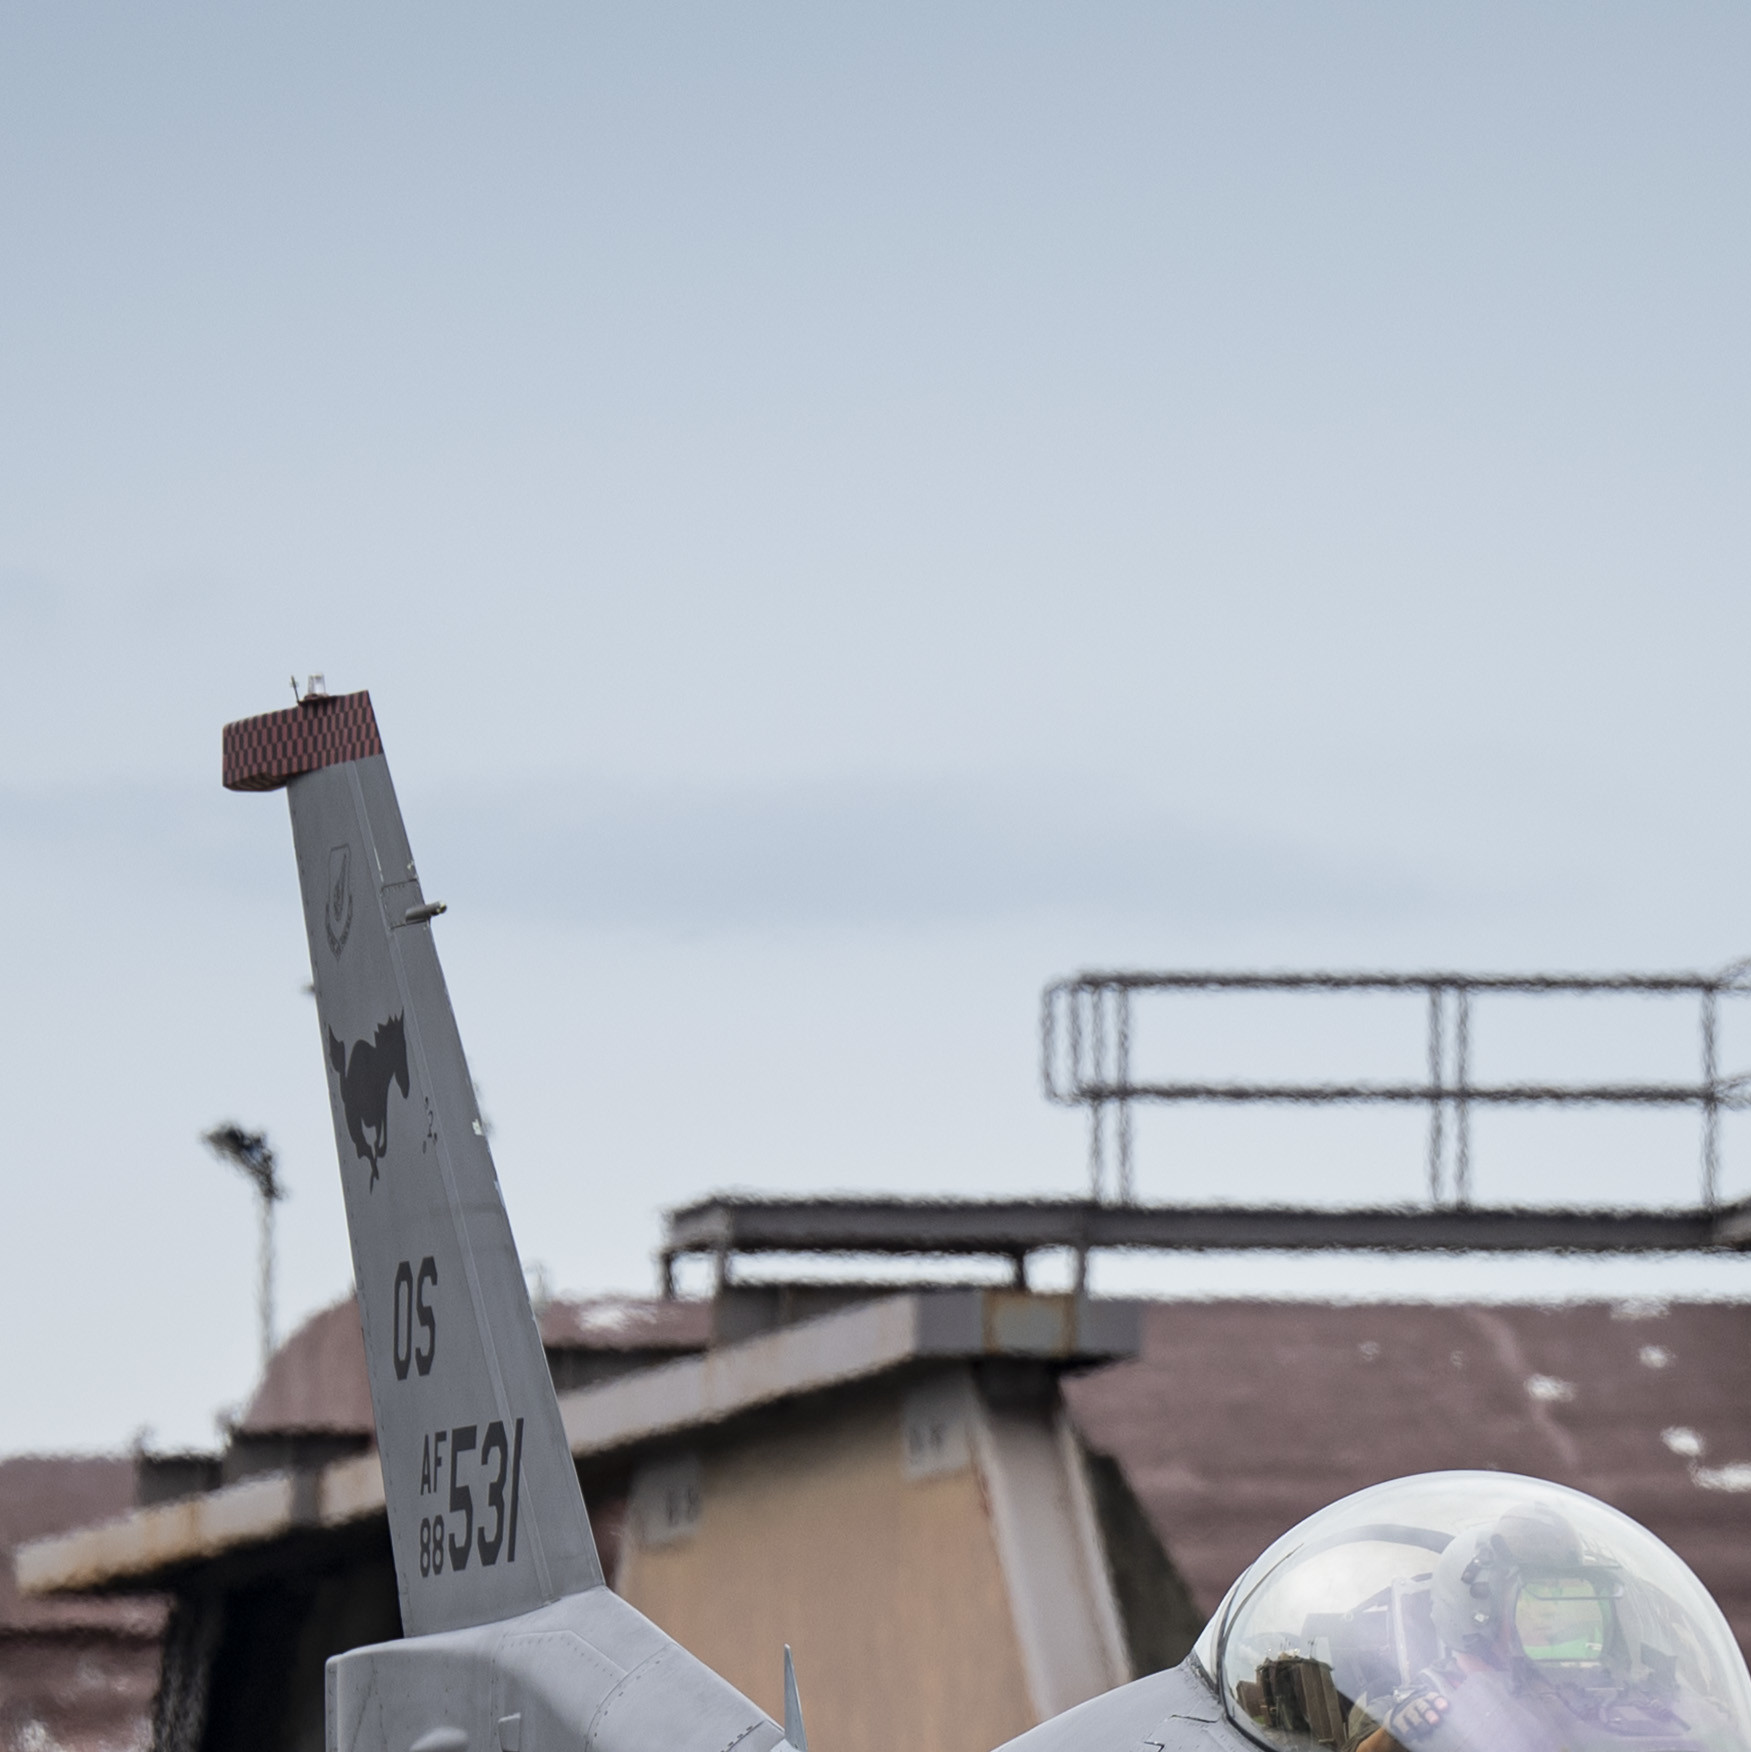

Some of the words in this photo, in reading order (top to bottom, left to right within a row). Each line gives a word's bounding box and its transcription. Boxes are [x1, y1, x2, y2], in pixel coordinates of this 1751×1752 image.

[393, 1255, 438, 1381] OS
[420, 1430, 447, 1496] AF
[448, 1417, 524, 1573] 531
[420, 1514, 445, 1578] 88
